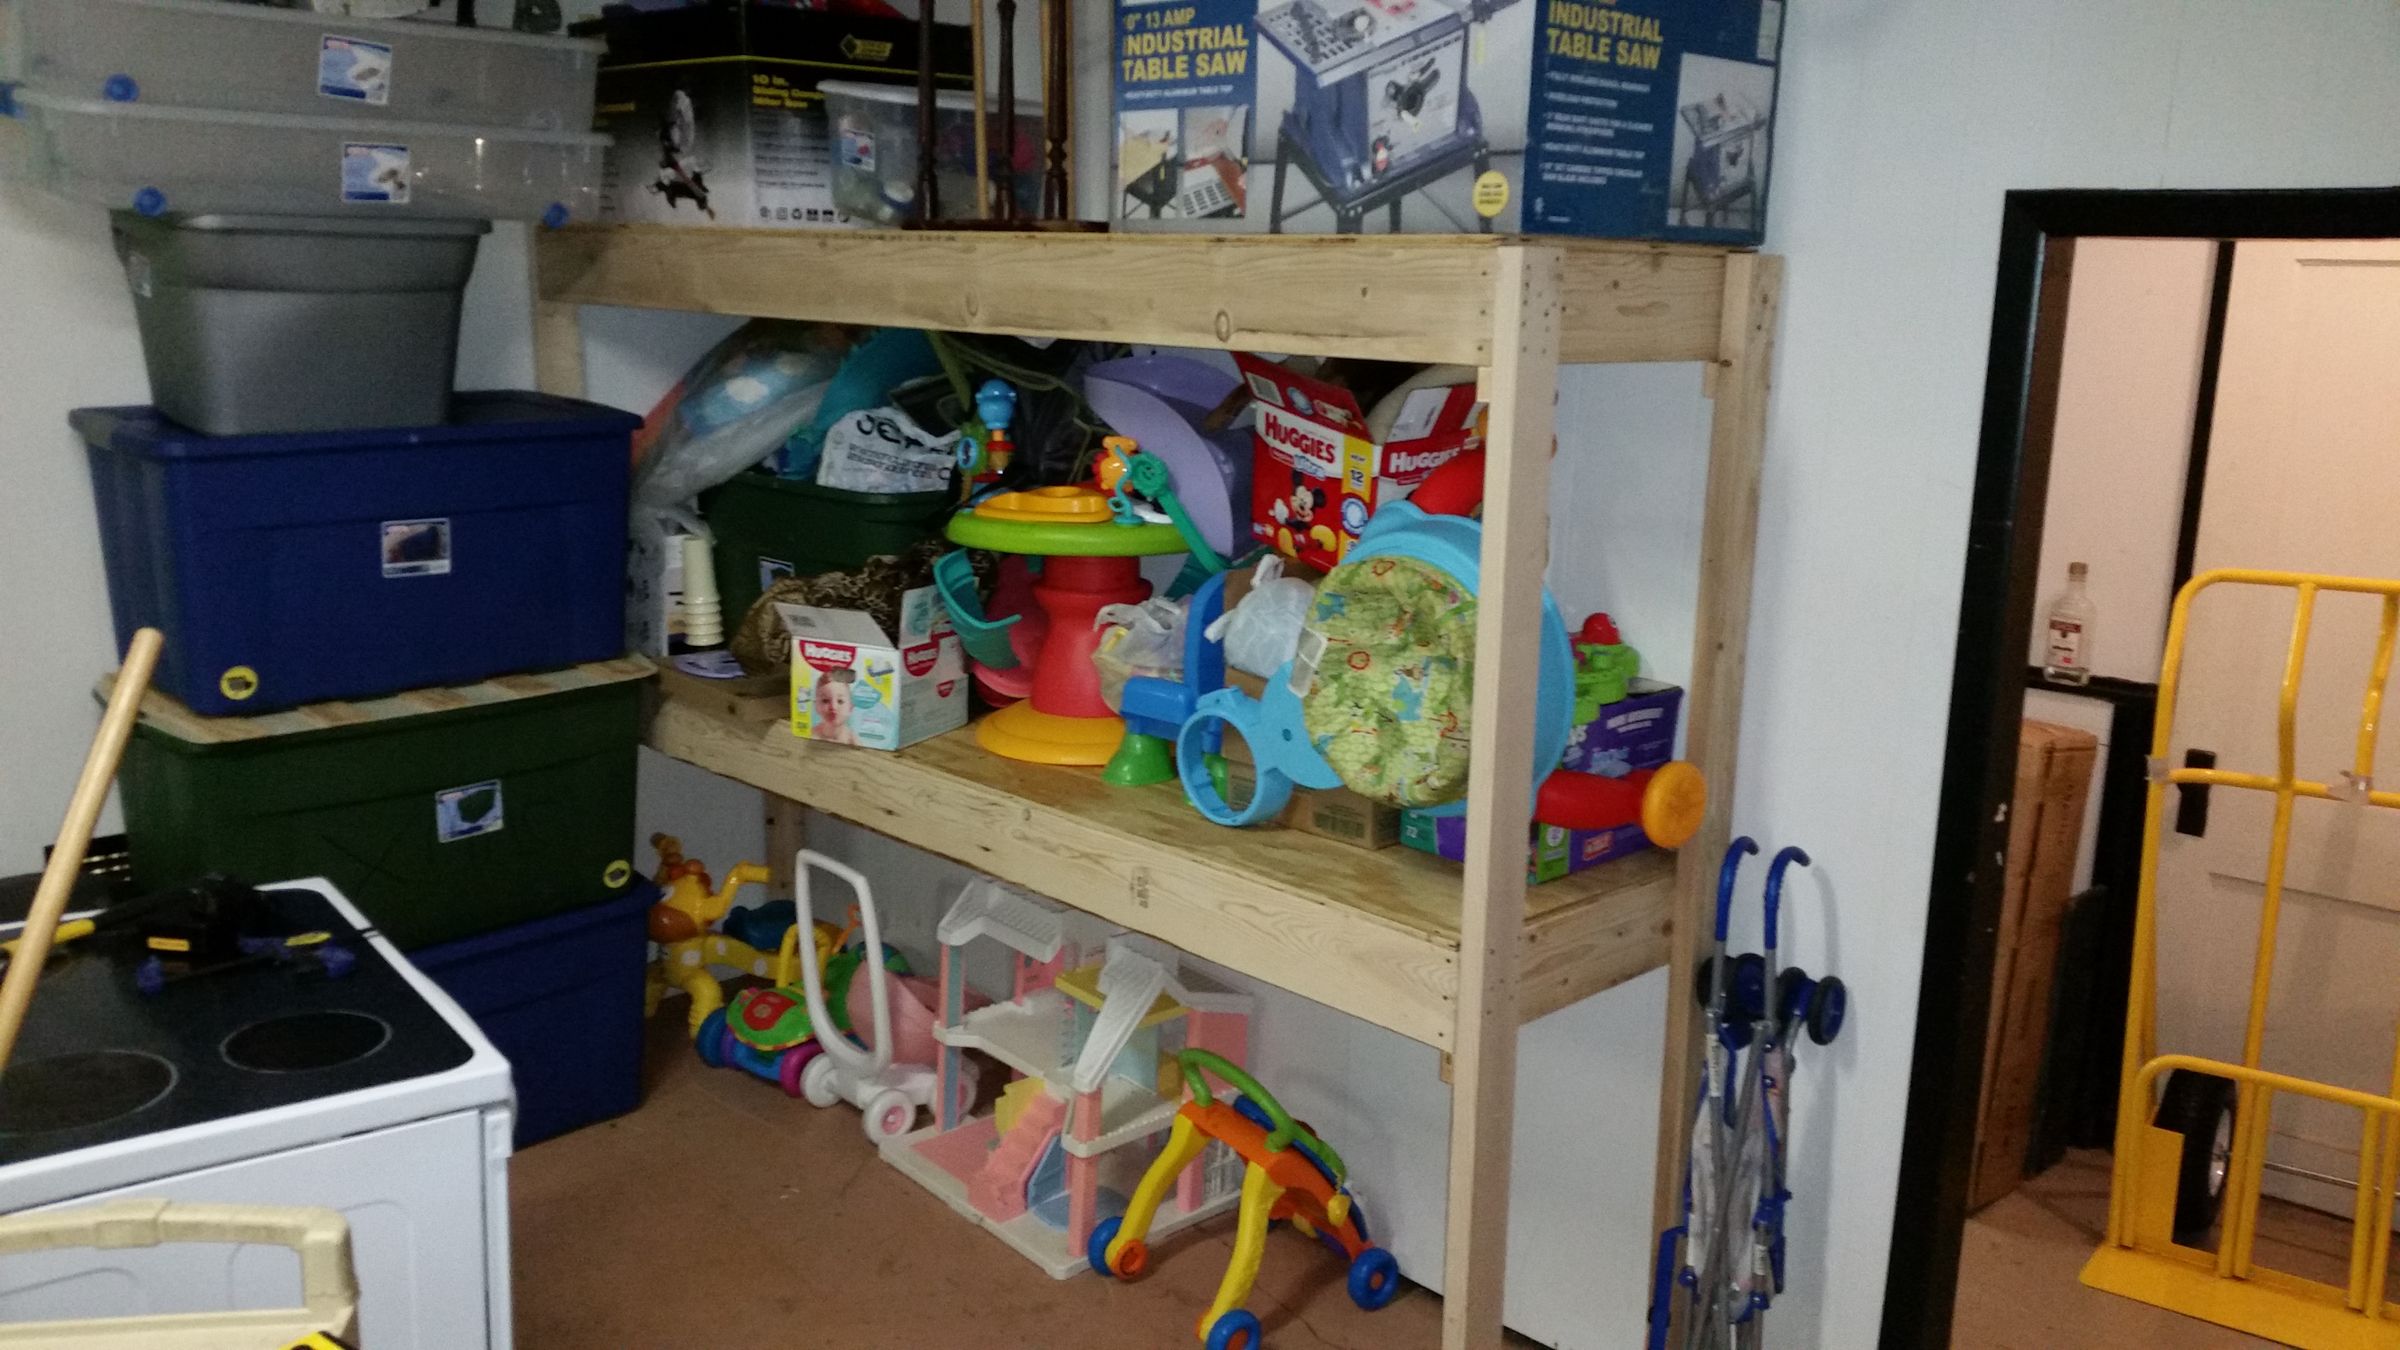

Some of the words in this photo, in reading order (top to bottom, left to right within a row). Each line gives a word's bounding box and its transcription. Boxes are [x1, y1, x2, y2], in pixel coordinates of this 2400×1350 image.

[1163, 6, 1196, 26] AMP
[1546, 1, 1664, 42] INDUSTRIAL
[1122, 55, 1190, 81] TABLE
[1195, 49, 1248, 77] SAW
[1546, 28, 1612, 62] TABLE
[1615, 40, 1661, 70] SAW
[1264, 411, 1336, 465] HUGGIES
